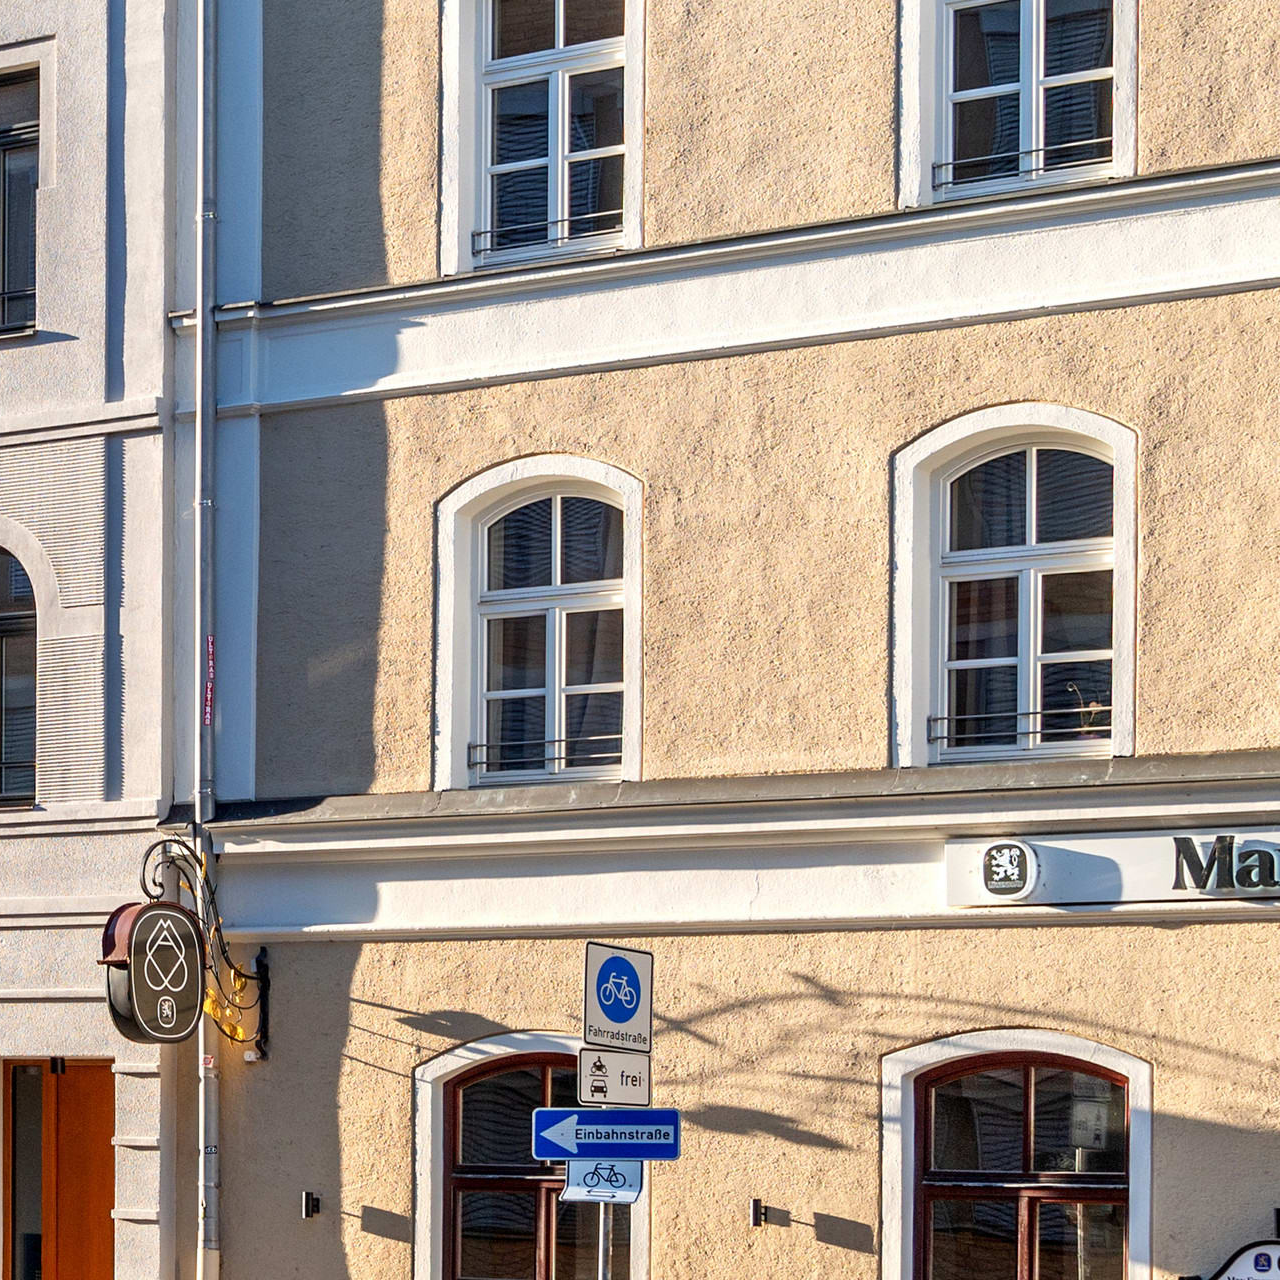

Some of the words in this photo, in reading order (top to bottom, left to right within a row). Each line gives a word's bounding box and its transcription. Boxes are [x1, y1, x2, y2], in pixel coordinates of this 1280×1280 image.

[1172, 835, 1280, 890] Ma
[588, 1025, 647, 1044] Fahrradstraße
[620, 1070, 642, 1087] frei
[575, 1128, 670, 1140] Einbahnstraße
